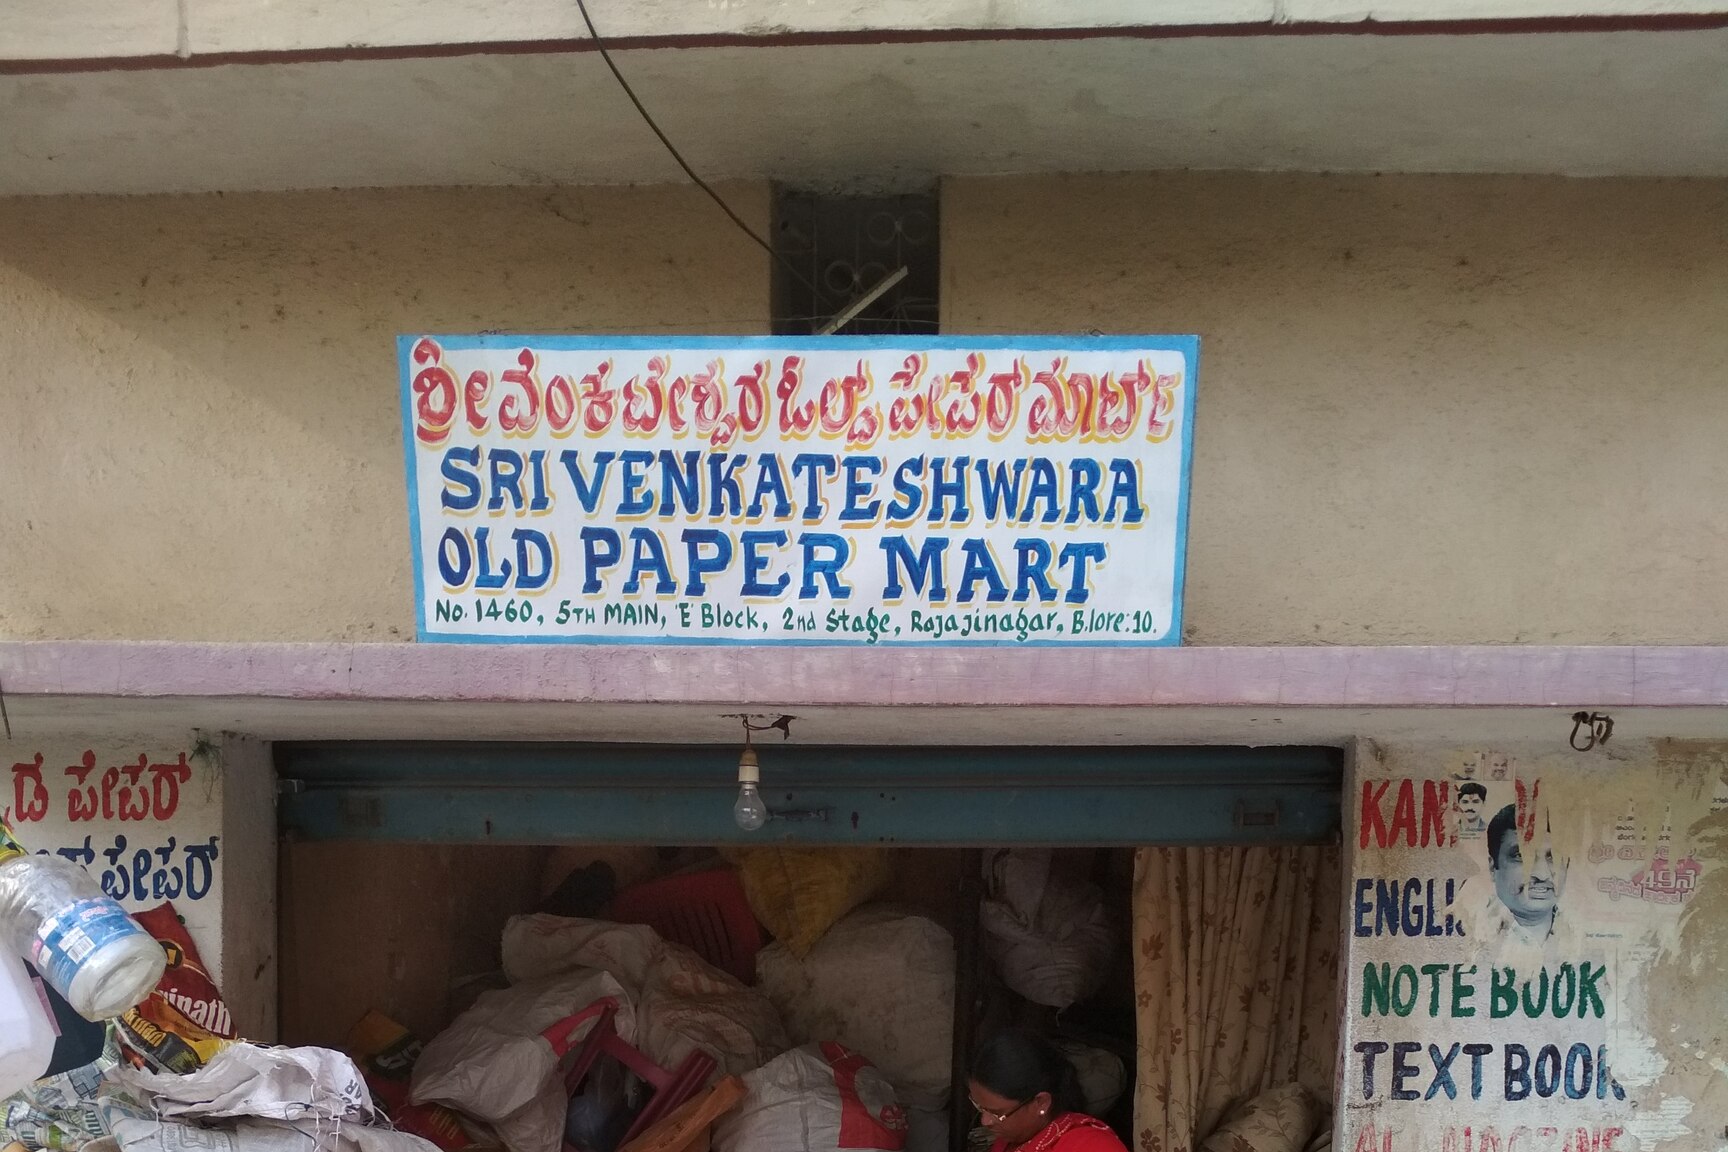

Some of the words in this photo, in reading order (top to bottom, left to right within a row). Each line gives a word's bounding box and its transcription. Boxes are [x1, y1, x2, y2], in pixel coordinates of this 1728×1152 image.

[441, 444, 549, 511] SRI
[560, 450, 1145, 523] VENKATESHWARA
[437, 527, 552, 590] OLD
[580, 527, 851, 600] PAPER
[879, 534, 1107, 603] MART
[436, 599, 468, 623] No.
[476, 600, 543, 625] 1460,
[555, 600, 596, 625] 5TH
[604, 603, 666, 630] MAIN,
[701, 603, 769, 633] Block,
[782, 608, 816, 632] 2nd
[826, 608, 901, 645] Stage,
[1361, 961, 1478, 1018] NOTE
[1489, 961, 1607, 1019] BOOK
[1353, 1041, 1494, 1101] TEXT
